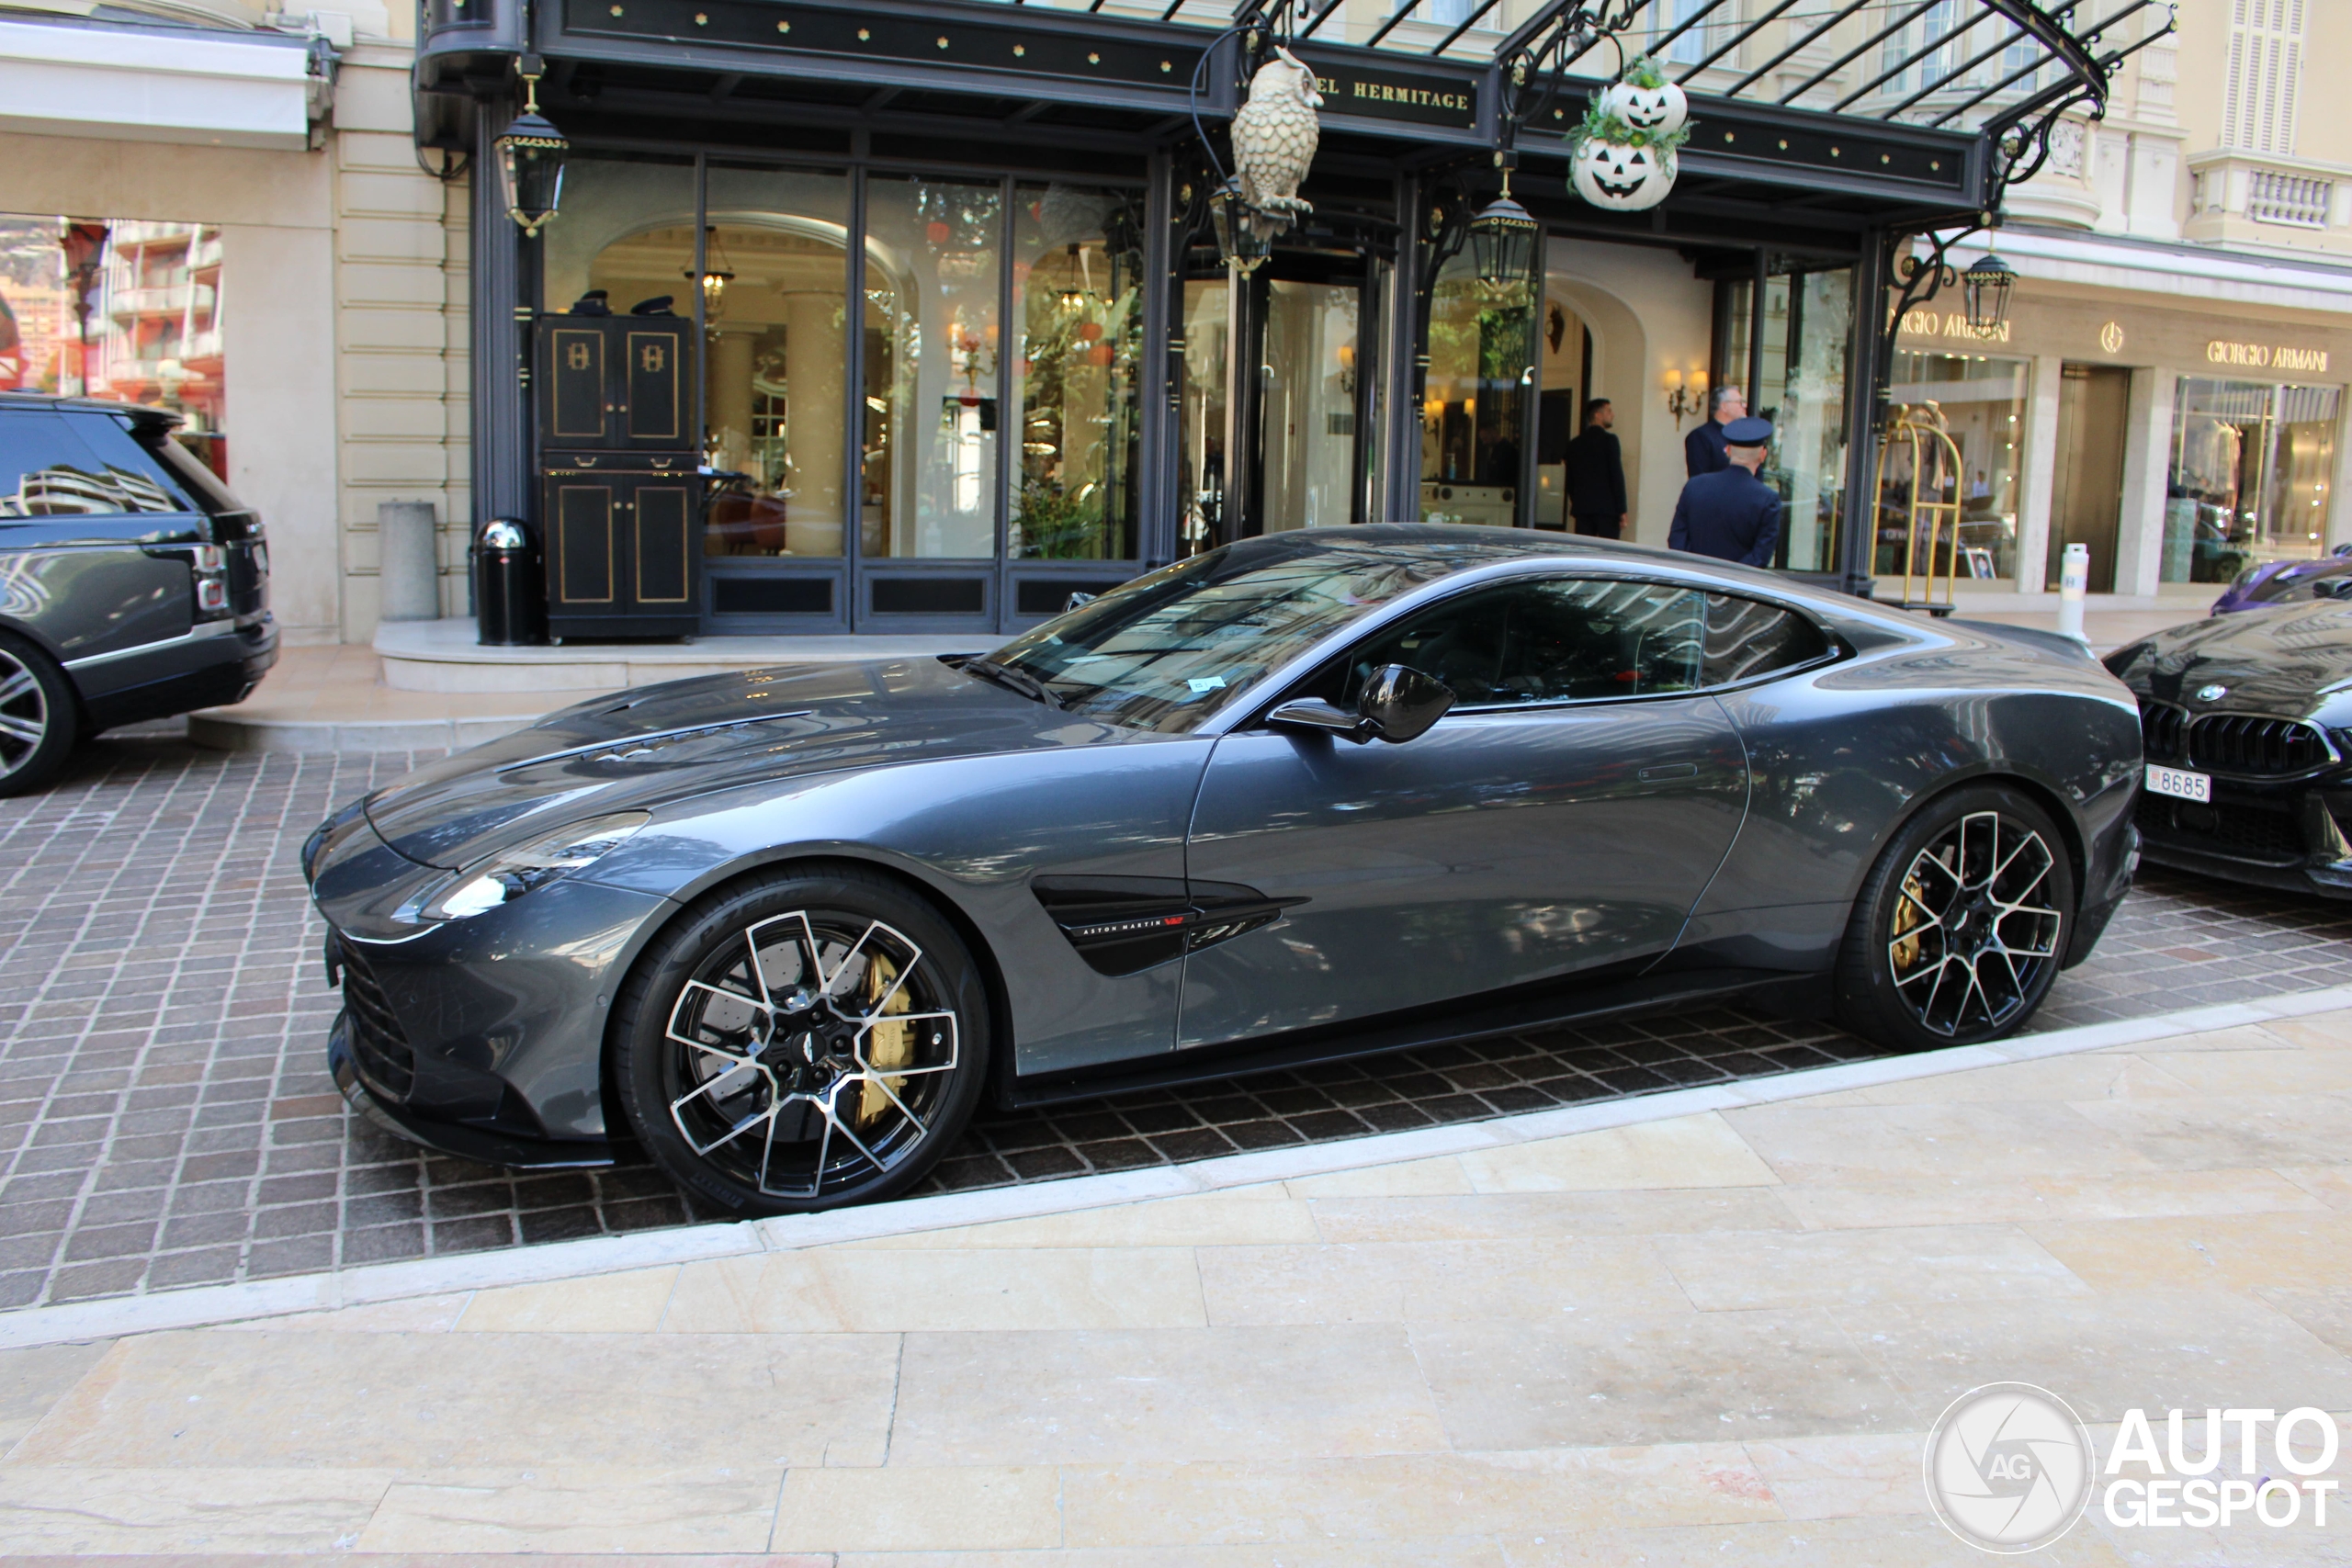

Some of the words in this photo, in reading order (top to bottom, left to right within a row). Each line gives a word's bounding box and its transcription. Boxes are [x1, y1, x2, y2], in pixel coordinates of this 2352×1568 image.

[1353, 82, 1468, 109] HERMITAGE
[2207, 340, 2268, 367] GIORGIO
[2271, 346, 2327, 372] ARMANI
[2162, 773, 2205, 797] 8685
[1083, 925, 1117, 935] ASTON
[1122, 919, 1161, 931] MARTIN
